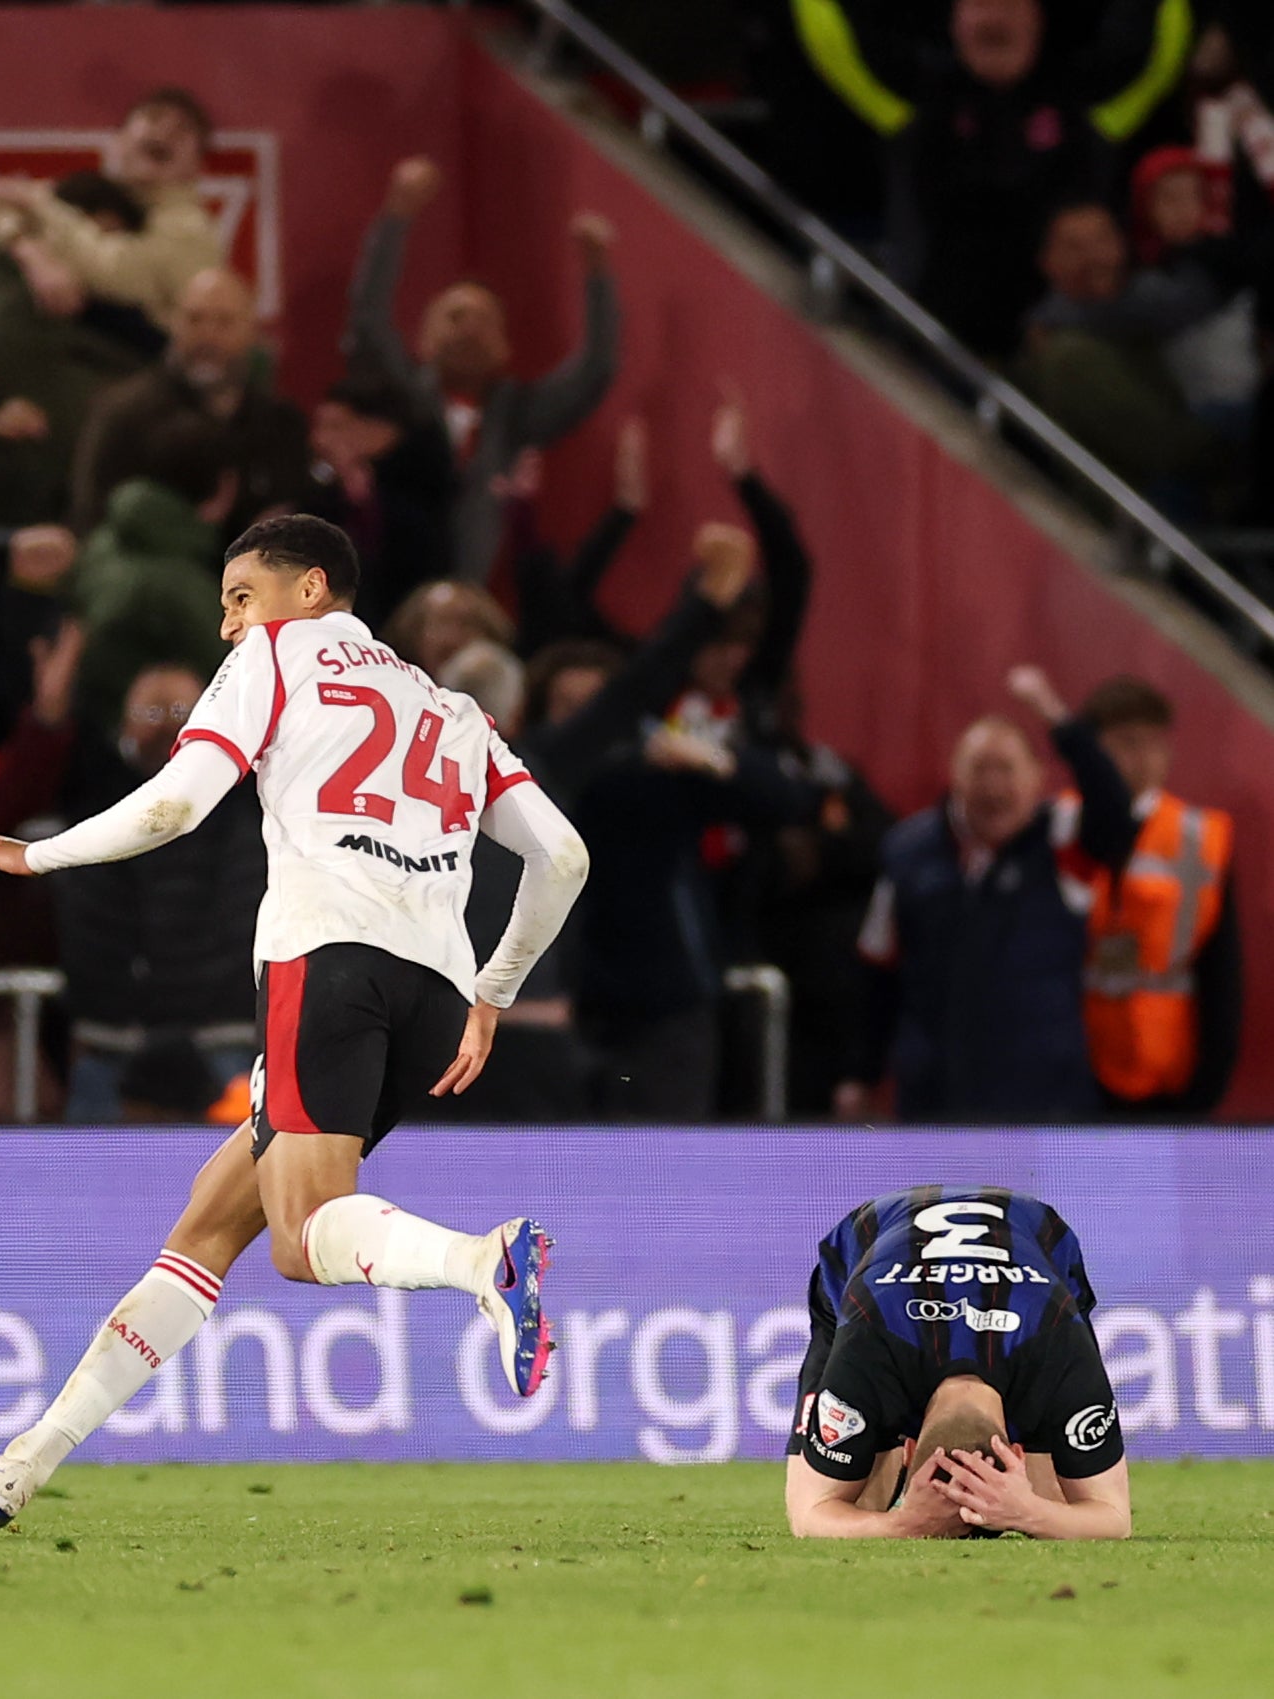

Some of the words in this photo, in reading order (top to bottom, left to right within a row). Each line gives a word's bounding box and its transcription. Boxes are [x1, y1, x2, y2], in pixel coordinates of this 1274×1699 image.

[317, 682, 476, 834] 24
[913, 1201, 1010, 1262] 3
[875, 1262, 1050, 1284] TARGETT
[108, 1316, 162, 1369] SAINTS
